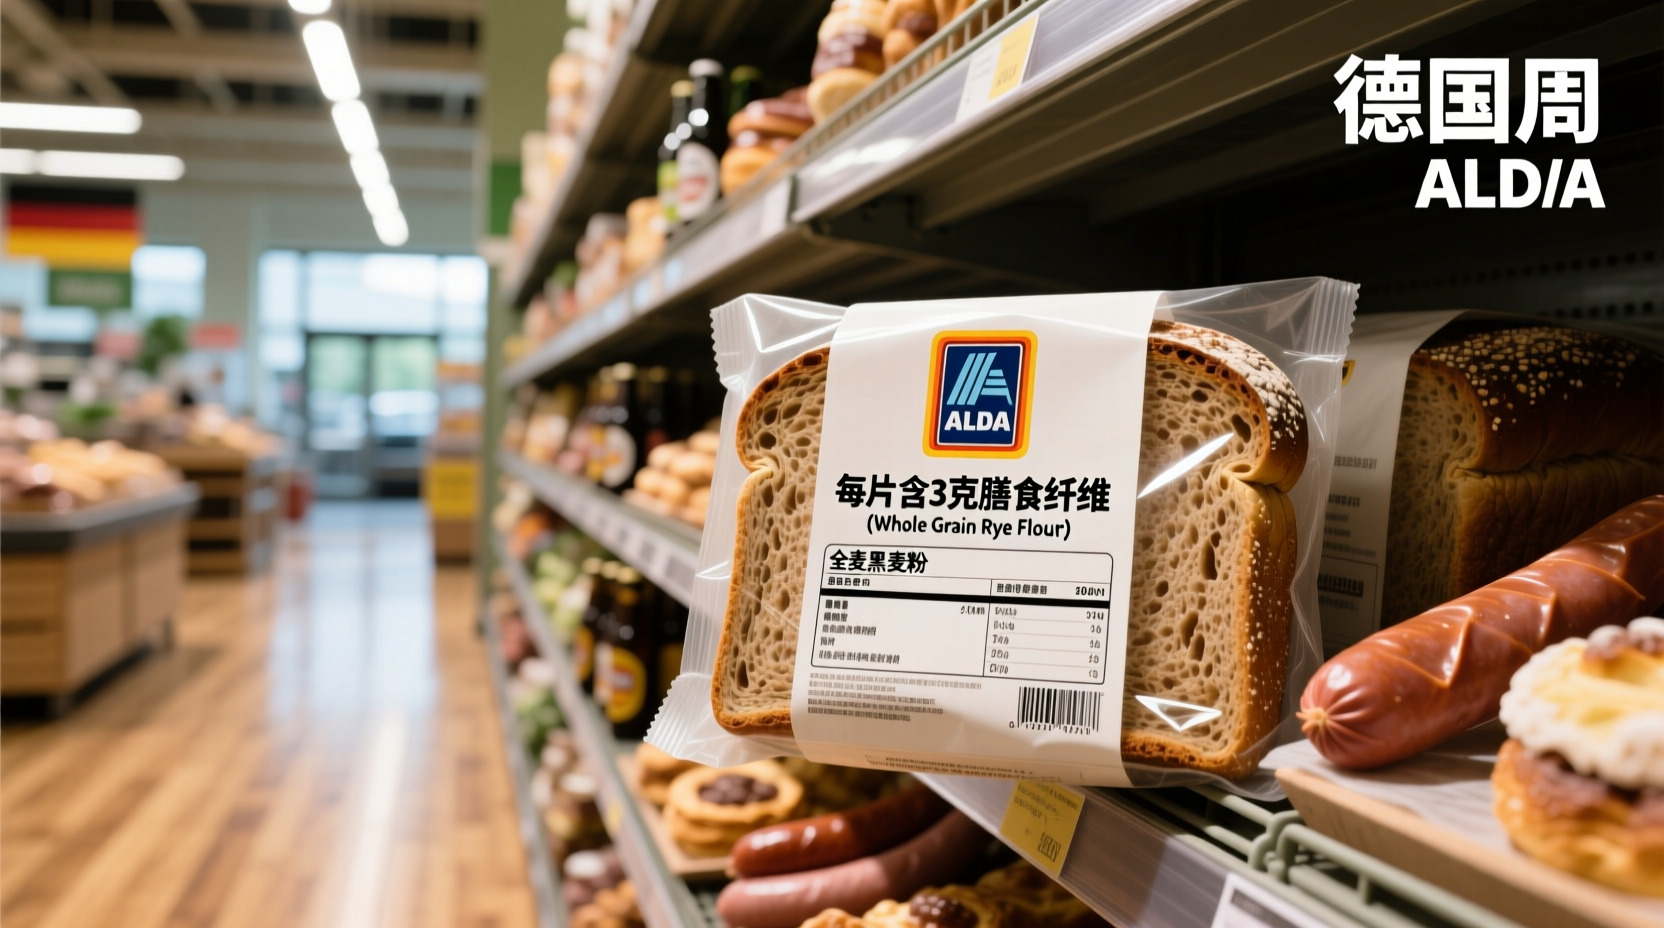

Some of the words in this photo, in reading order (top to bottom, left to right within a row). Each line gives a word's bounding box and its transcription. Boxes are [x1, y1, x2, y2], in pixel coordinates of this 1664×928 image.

[944, 411, 1011, 432] ALDA
[835, 473, 1112, 513] 每片含3克膳食纤维
[867, 514, 928, 535] (Whole
[931, 516, 977, 535] Grain
[981, 518, 1013, 541] Rye
[1017, 518, 1071, 542] Flour)
[829, 548, 929, 574] 全麦黑麦粉
